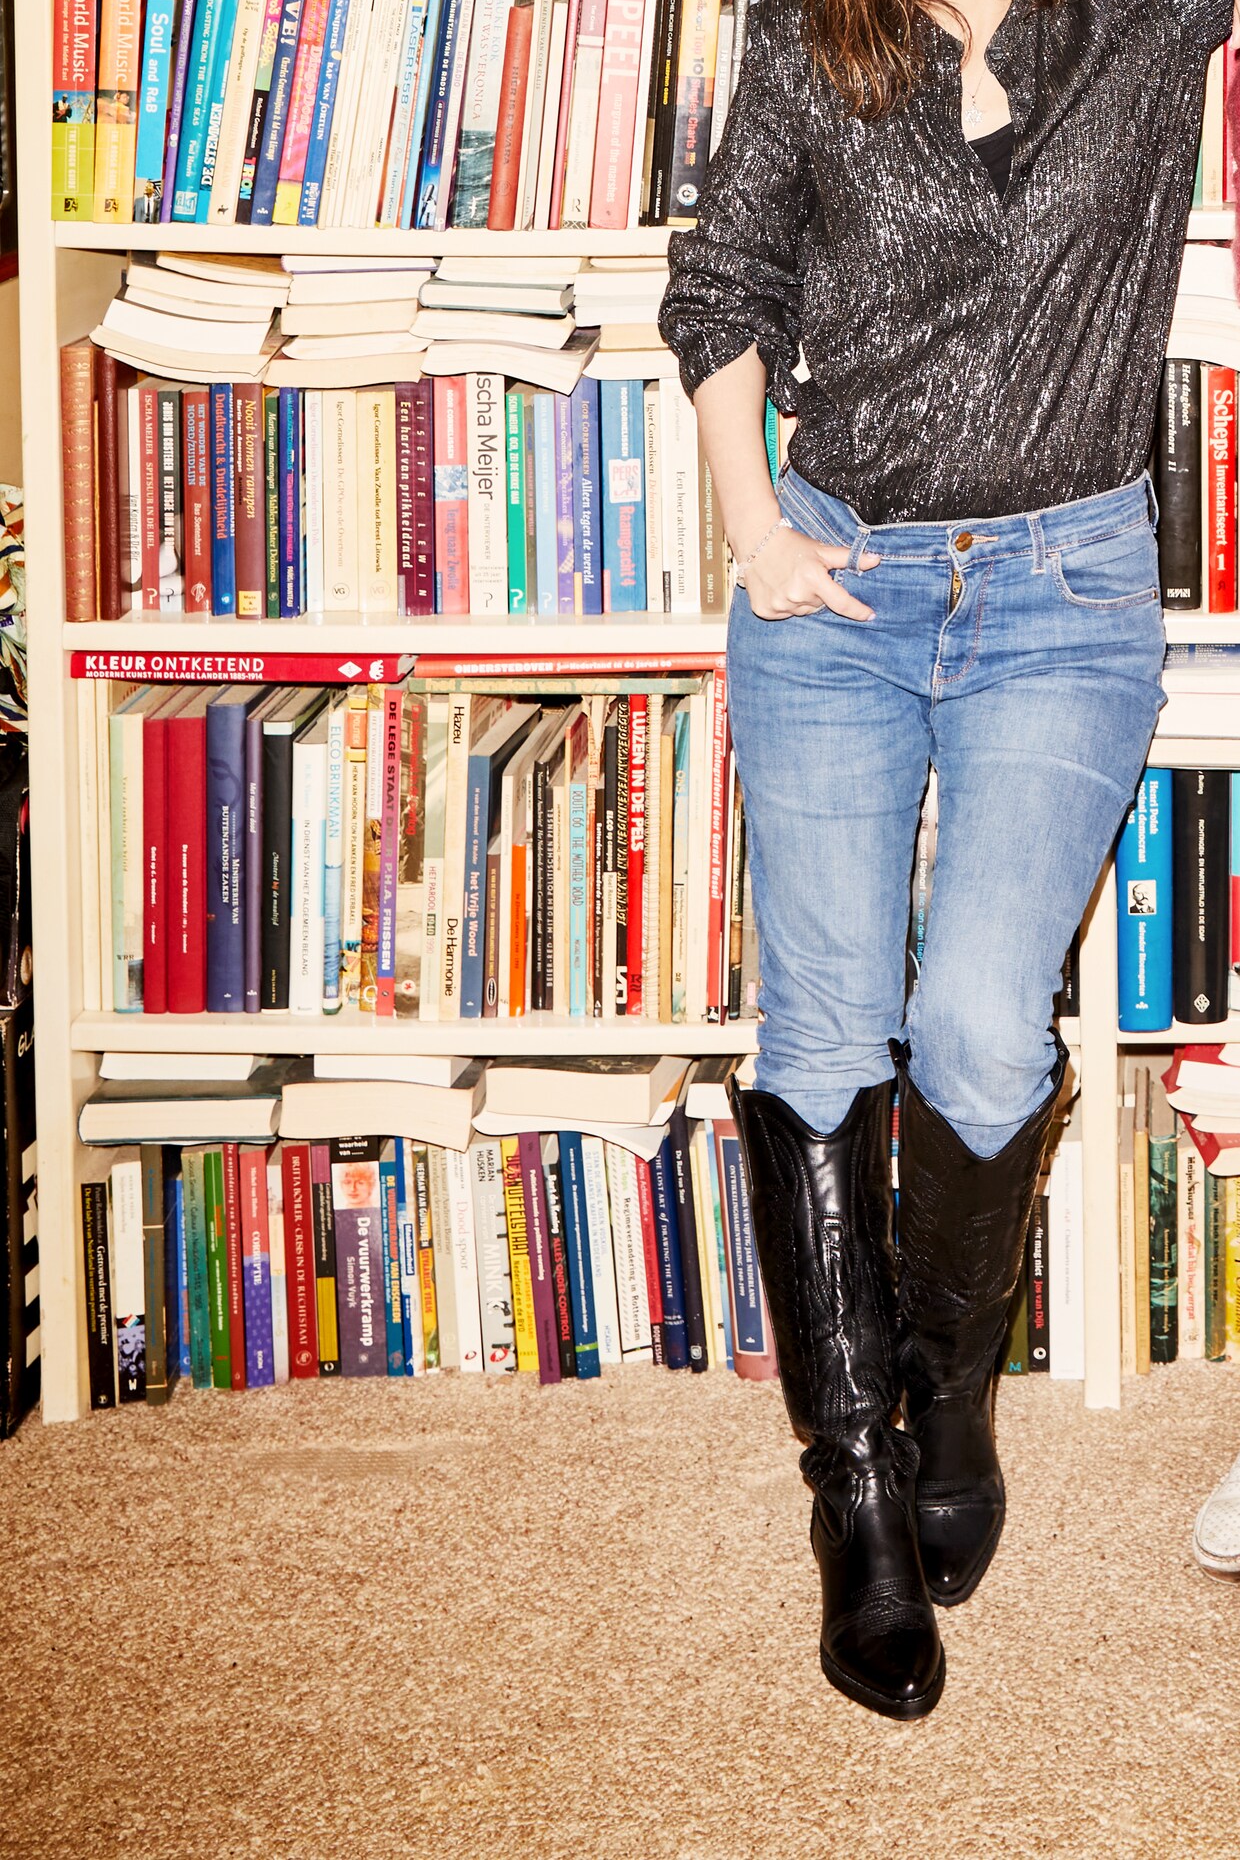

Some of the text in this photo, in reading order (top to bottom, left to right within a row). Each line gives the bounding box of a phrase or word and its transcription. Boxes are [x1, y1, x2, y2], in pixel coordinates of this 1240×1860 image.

[72, 33, 90, 84] Music
[145, 12, 168, 113] Soul and R&B
[603, 0, 641, 85] PEEL
[201, 103, 224, 186] DE STEMMEN
[605, 93, 624, 203] margrave of the marshes
[241, 399, 257, 519] Nooit komen rampen
[1210, 389, 1233, 460] Scheps
[1215, 464, 1229, 546] inventariseert
[86, 656, 265, 673] KLEUR ONTKETEND
[328, 726, 342, 838] ELCO BRINKMAN
[631, 711, 646, 852] LUIZEN IN DE PELS
[346, 1256, 357, 1309] Simon Vuyk
[356, 1216, 374, 1347] De vuurwerkramp
